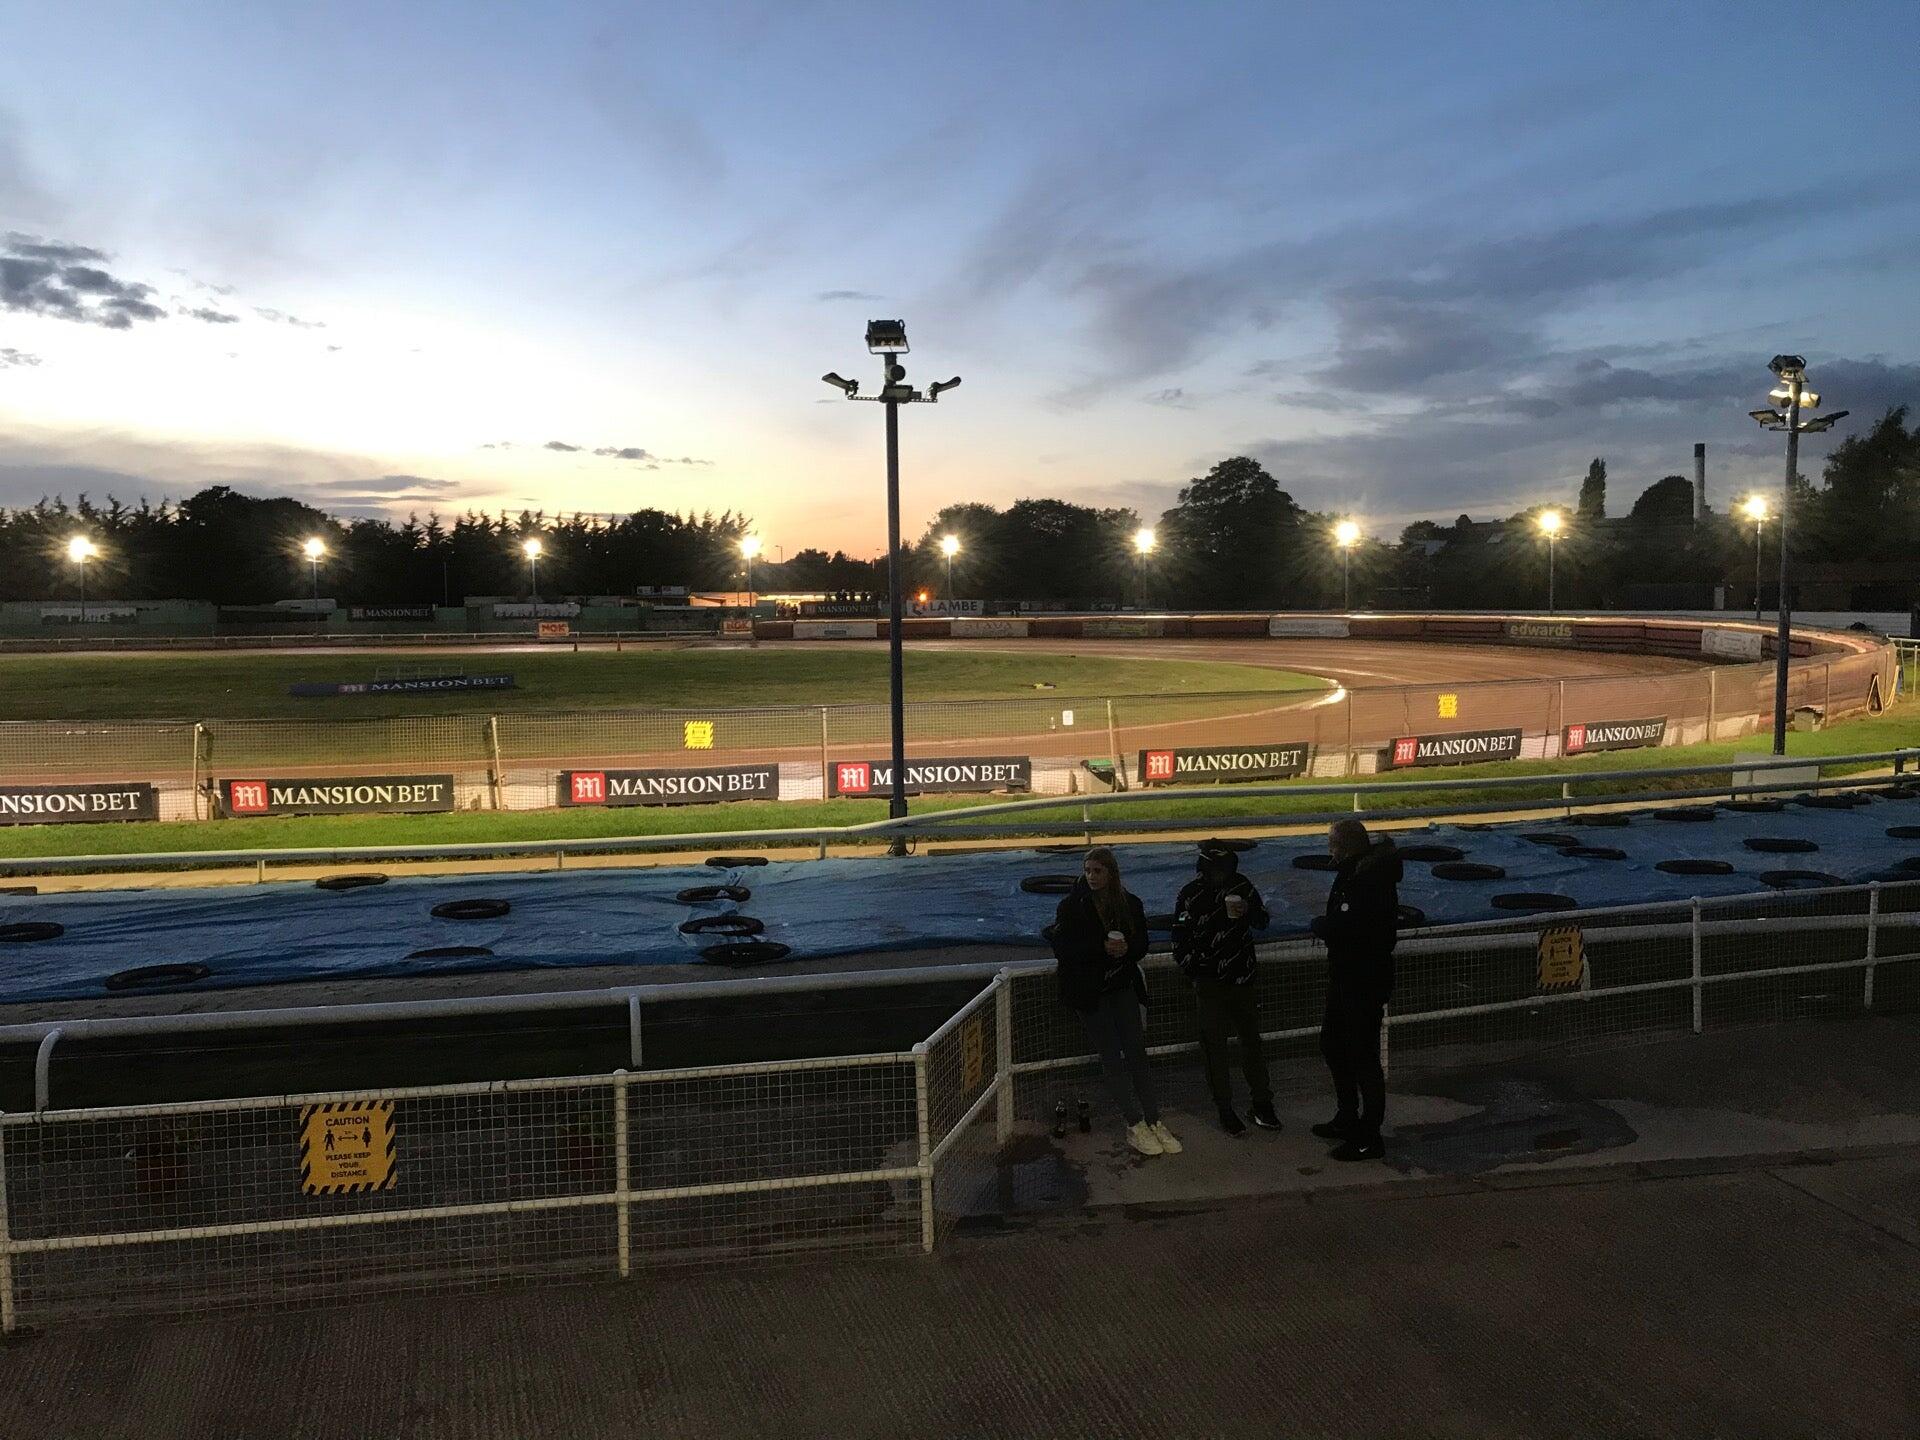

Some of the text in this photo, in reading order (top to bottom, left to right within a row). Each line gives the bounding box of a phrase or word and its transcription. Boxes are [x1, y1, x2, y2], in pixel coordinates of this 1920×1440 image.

[1510, 623, 1573, 637] edwards
[326, 1115, 370, 1127] CAUTION
[325, 1151, 371, 1161] PLEASE KEEP
[331, 1169, 367, 1178] DISTANCE
